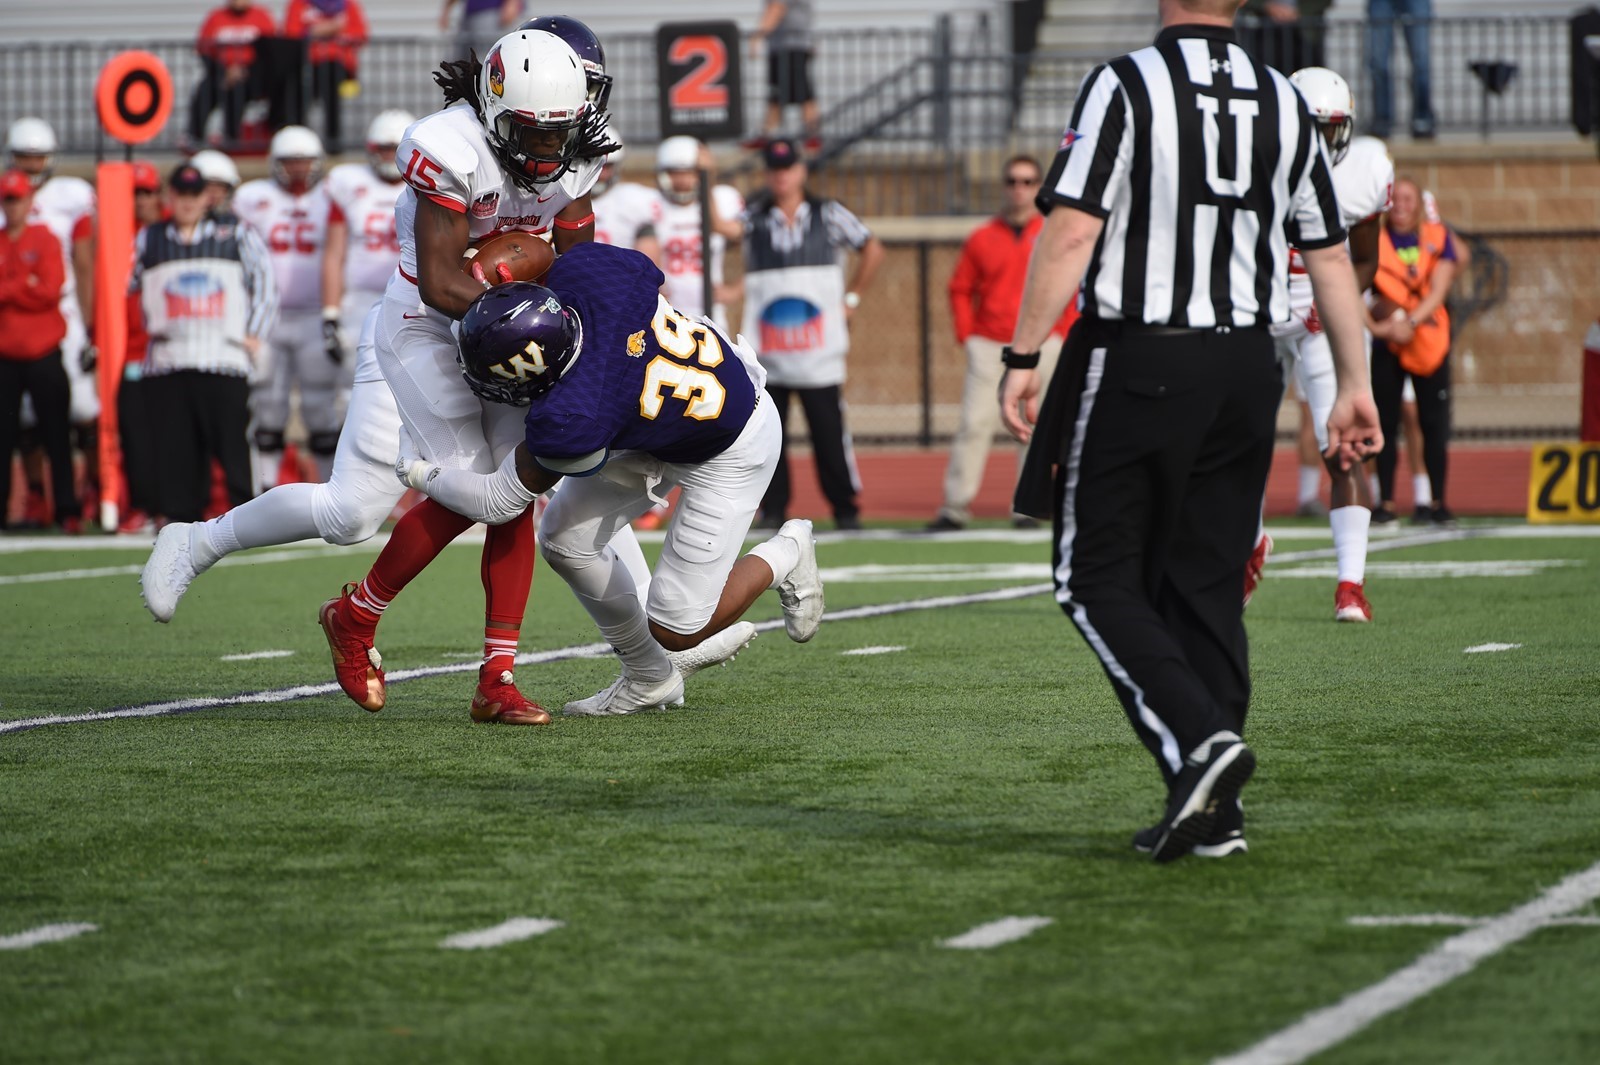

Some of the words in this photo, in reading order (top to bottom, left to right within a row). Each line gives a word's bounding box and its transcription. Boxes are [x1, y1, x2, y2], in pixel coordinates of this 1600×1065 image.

[668, 35, 729, 109] 2
[403, 149, 443, 191] 15
[1196, 93, 1260, 198] U
[489, 341, 549, 384] W
[640, 293, 727, 421] 39
[1538, 449, 1600, 511] 20
